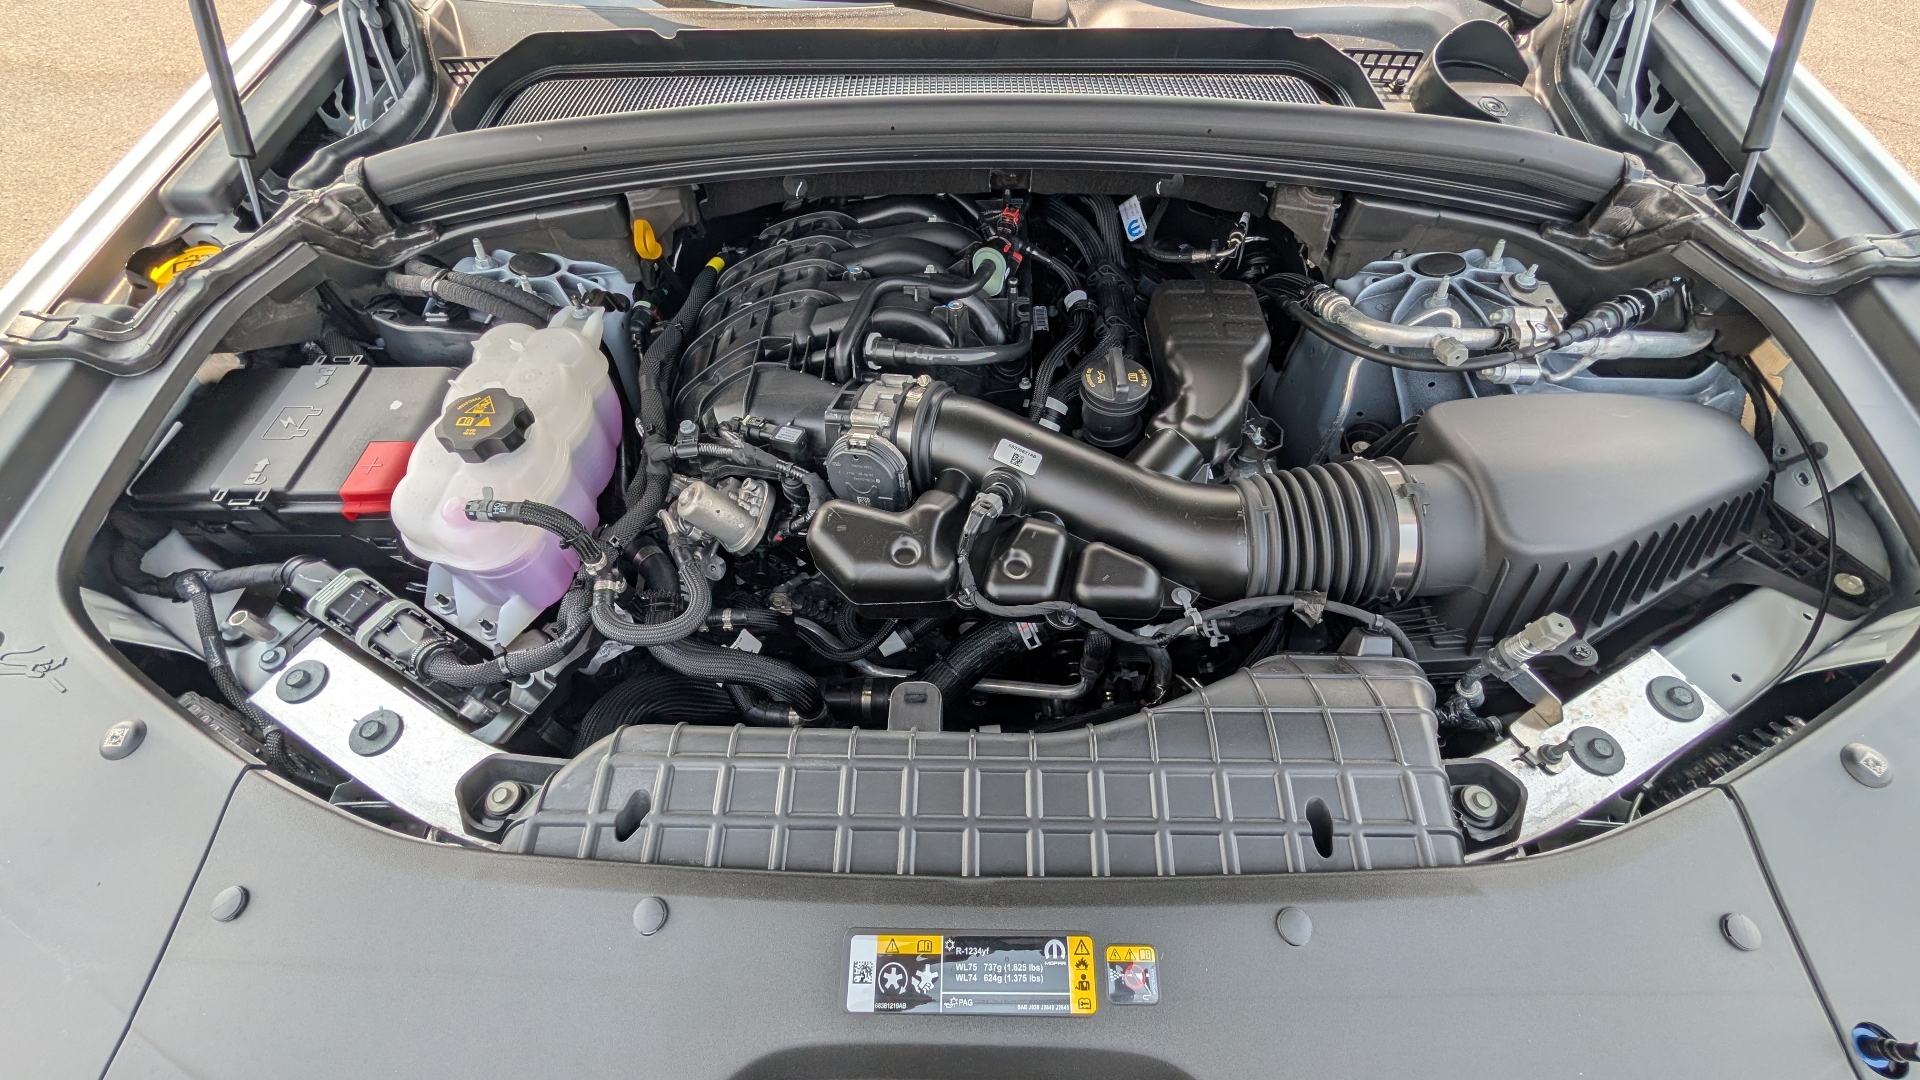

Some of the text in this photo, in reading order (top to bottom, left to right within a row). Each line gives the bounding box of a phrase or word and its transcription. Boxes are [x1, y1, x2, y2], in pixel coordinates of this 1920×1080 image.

[955, 947, 990, 956] R-1234yf
[955, 963, 1044, 973] WL75 737g (1.625 lbs)
[955, 974, 1044, 984] WL74 624g (1.375 lbs)
